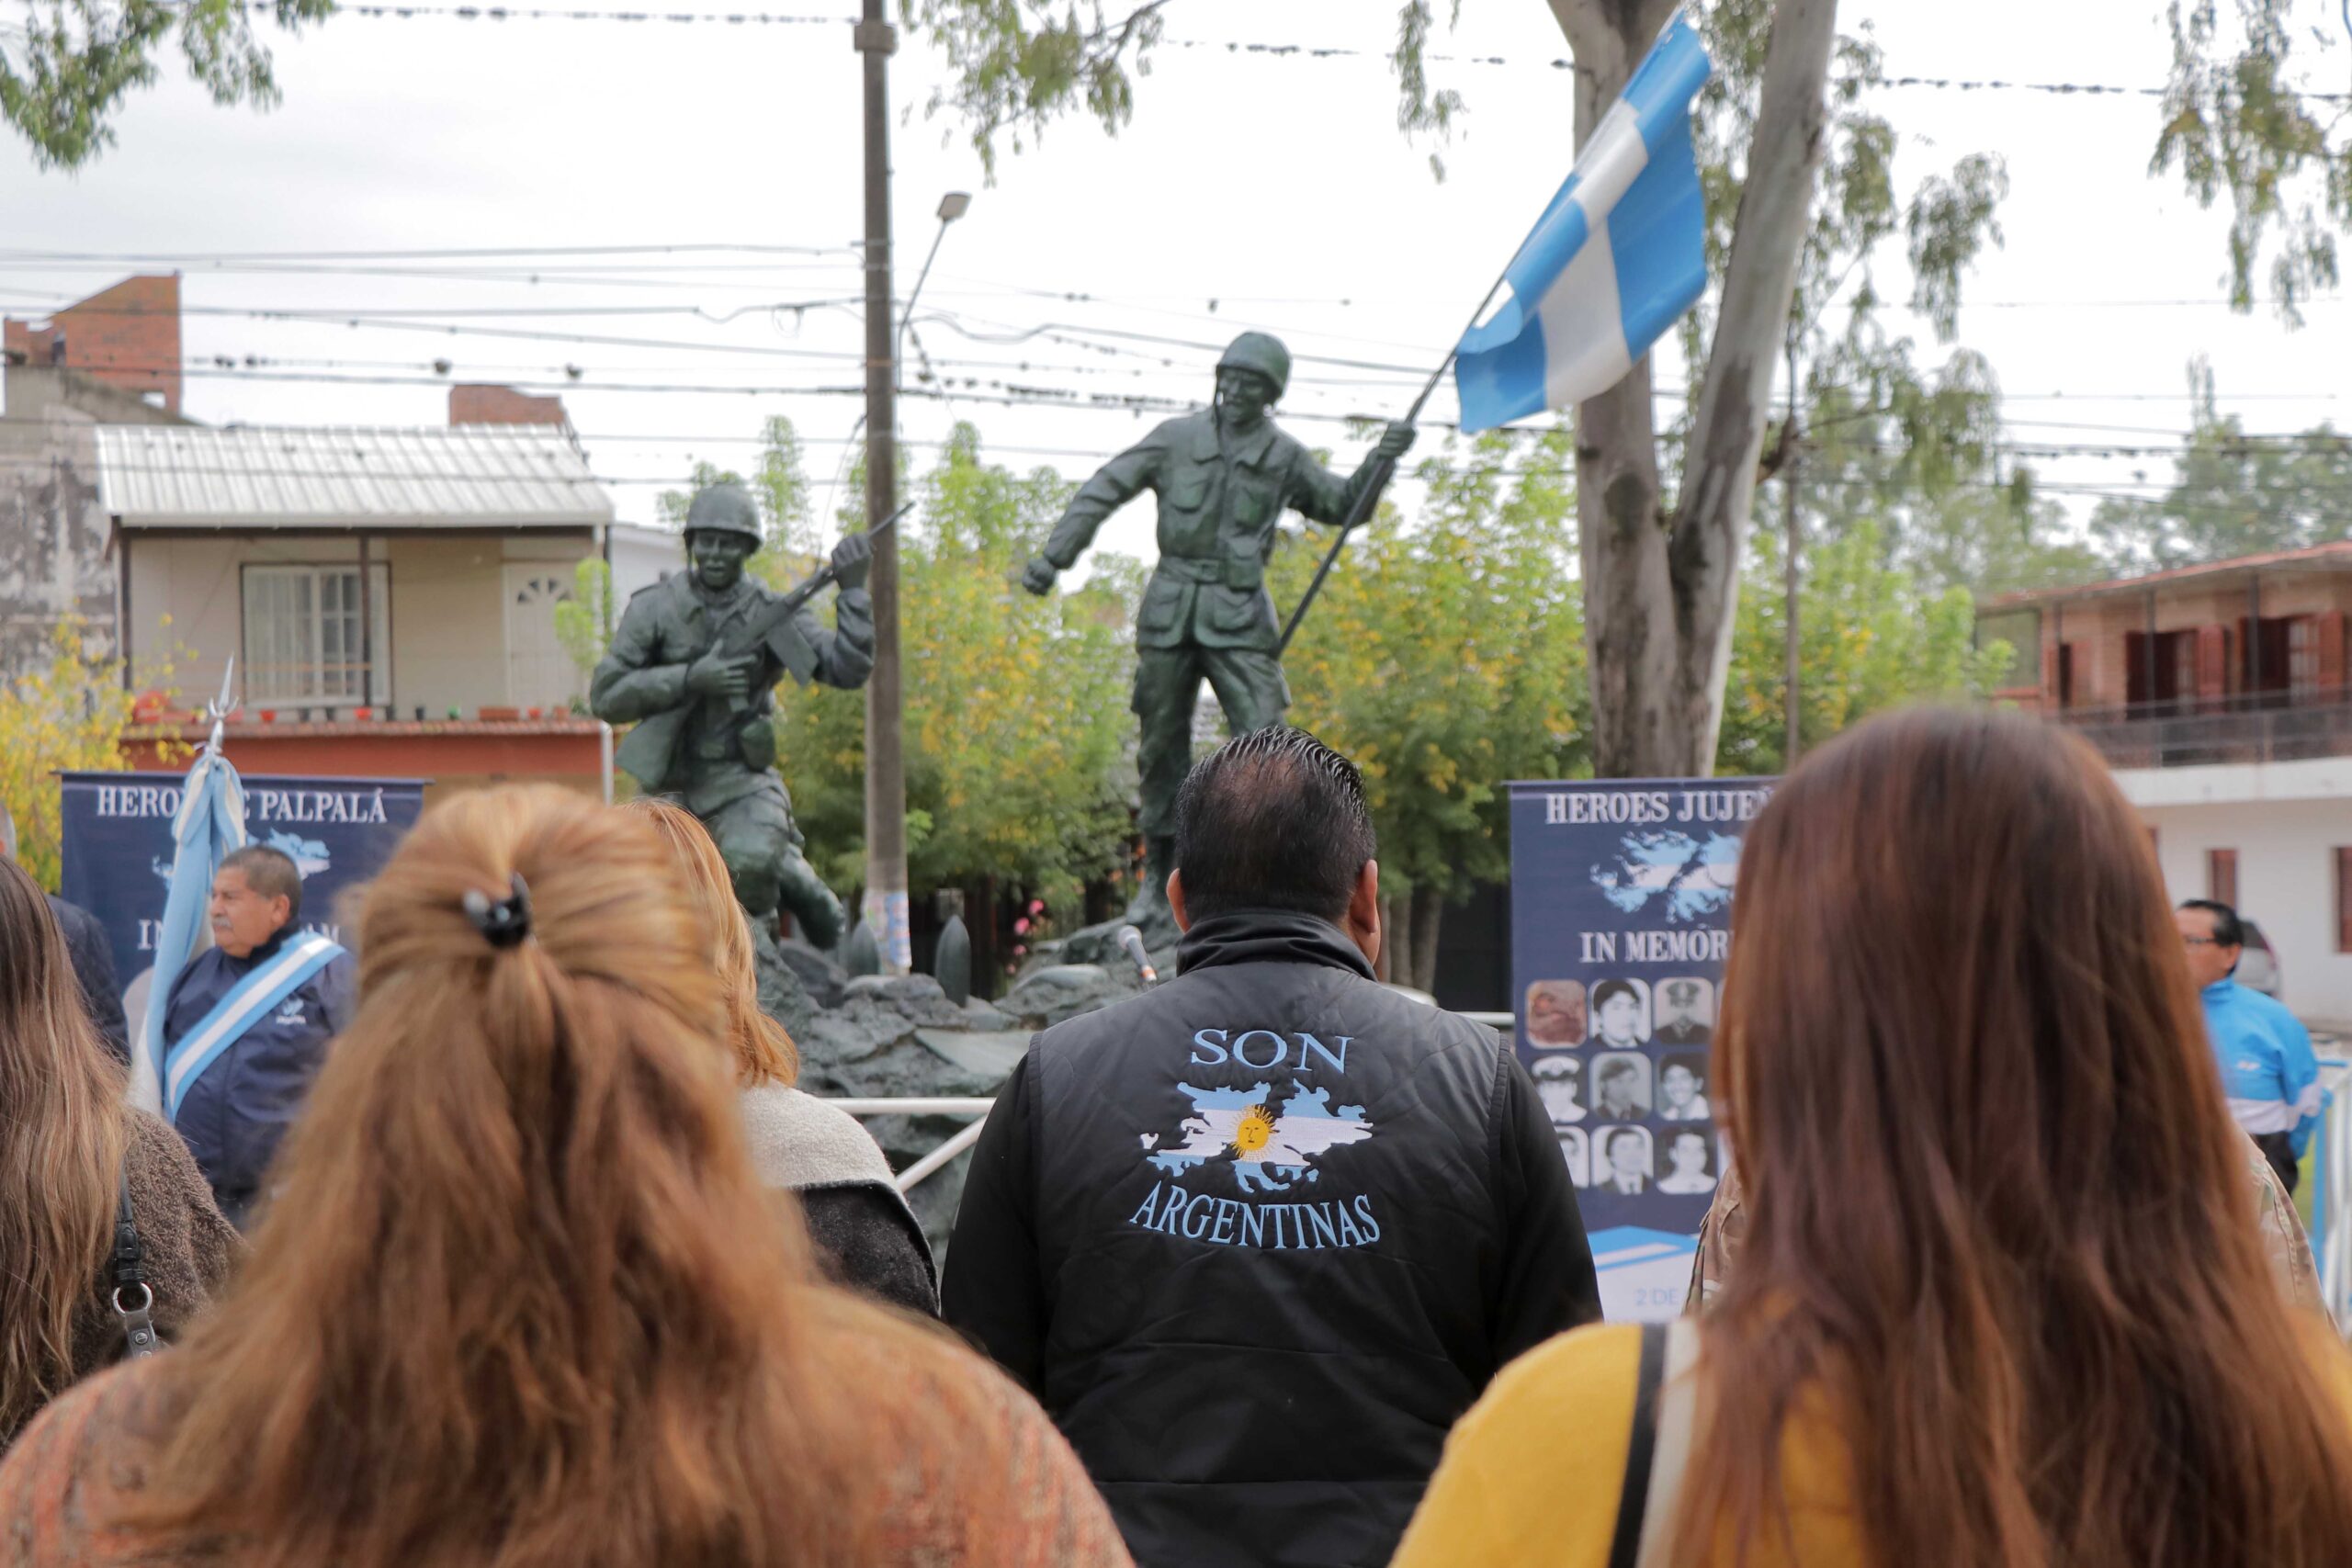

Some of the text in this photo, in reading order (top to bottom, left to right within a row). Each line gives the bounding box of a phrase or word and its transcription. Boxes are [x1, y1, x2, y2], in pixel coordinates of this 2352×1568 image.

[96, 784, 184, 818] HERO
[259, 787, 388, 823] PALPALÁ
[1545, 792, 1669, 824] HEROES
[1579, 929, 1734, 963] IN MEMOR
[1191, 1029, 1354, 1074] SON
[1129, 1180, 1380, 1249] ARGENTINAS
[1635, 1288, 1647, 1306] 2
